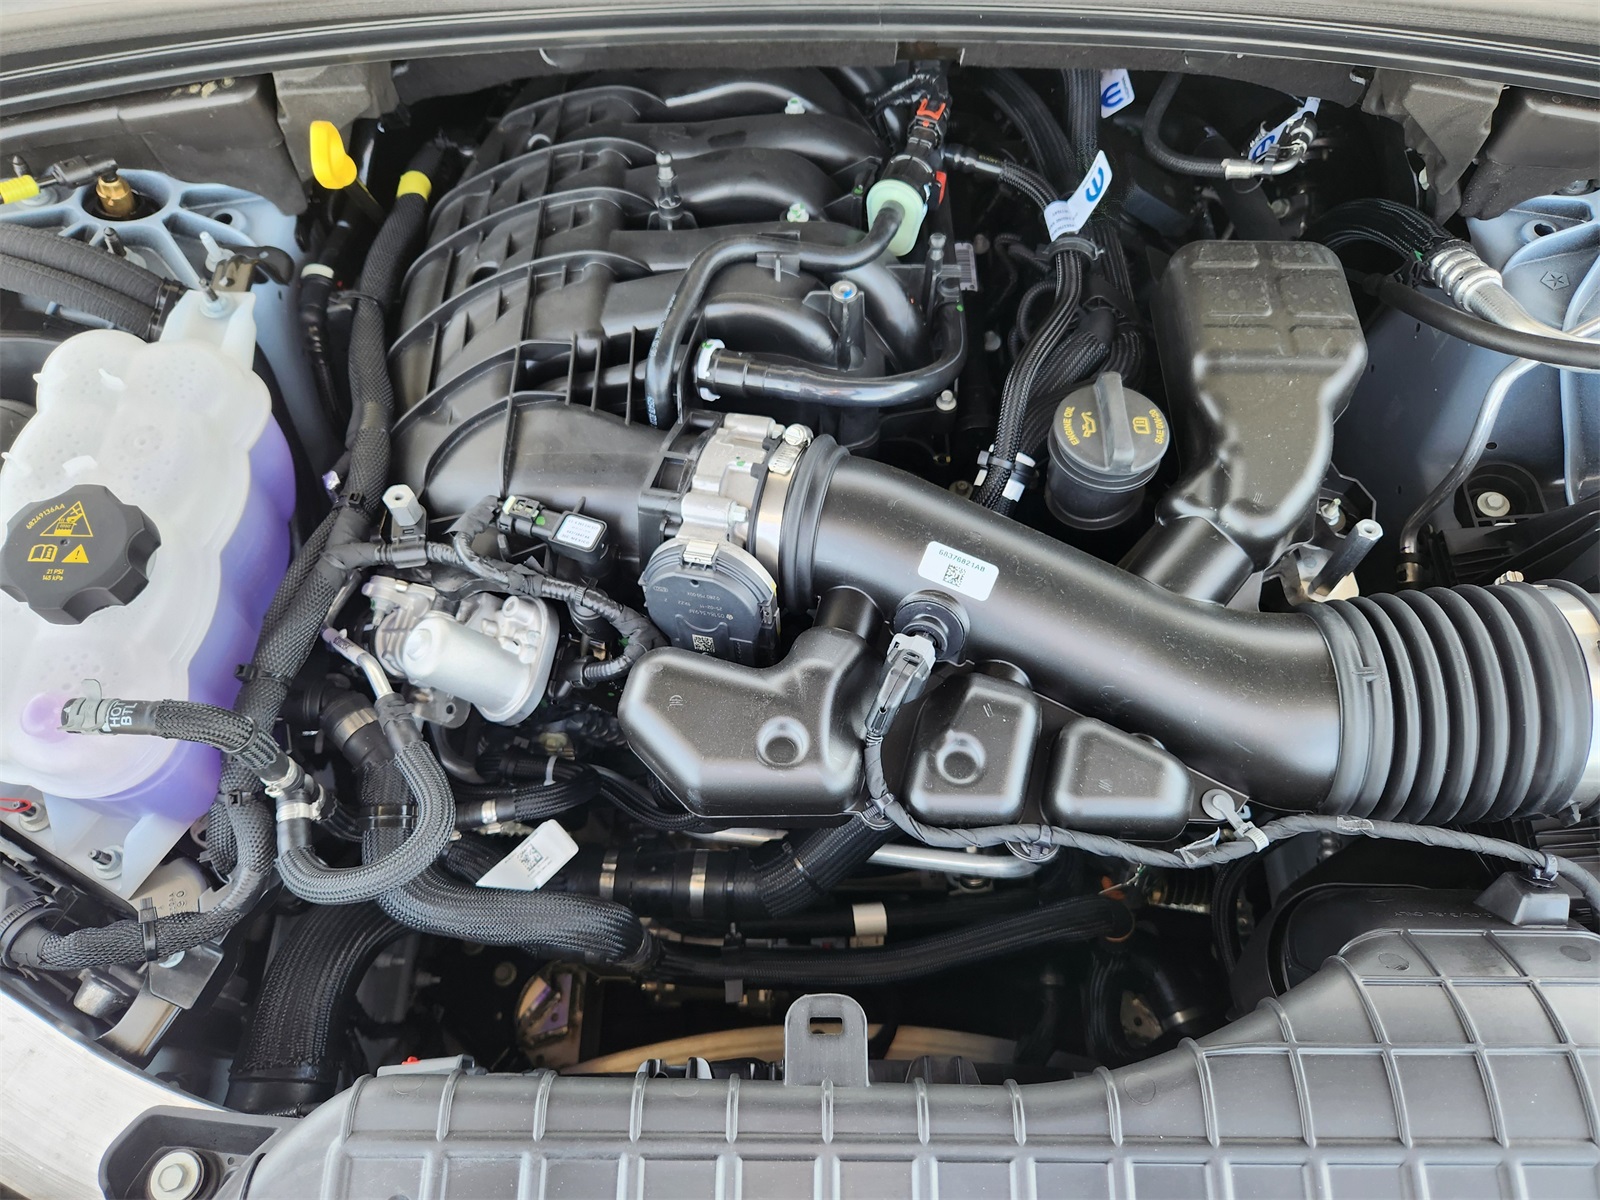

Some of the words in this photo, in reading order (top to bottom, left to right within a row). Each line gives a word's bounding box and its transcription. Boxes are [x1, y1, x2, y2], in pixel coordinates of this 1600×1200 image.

[1063, 406, 1076, 418] OIL
[1063, 418, 1080, 446] ENGINE
[1154, 429, 1165, 445] SAE
[109, 700, 126, 728] HOT
[120, 702, 138, 726] BTL
